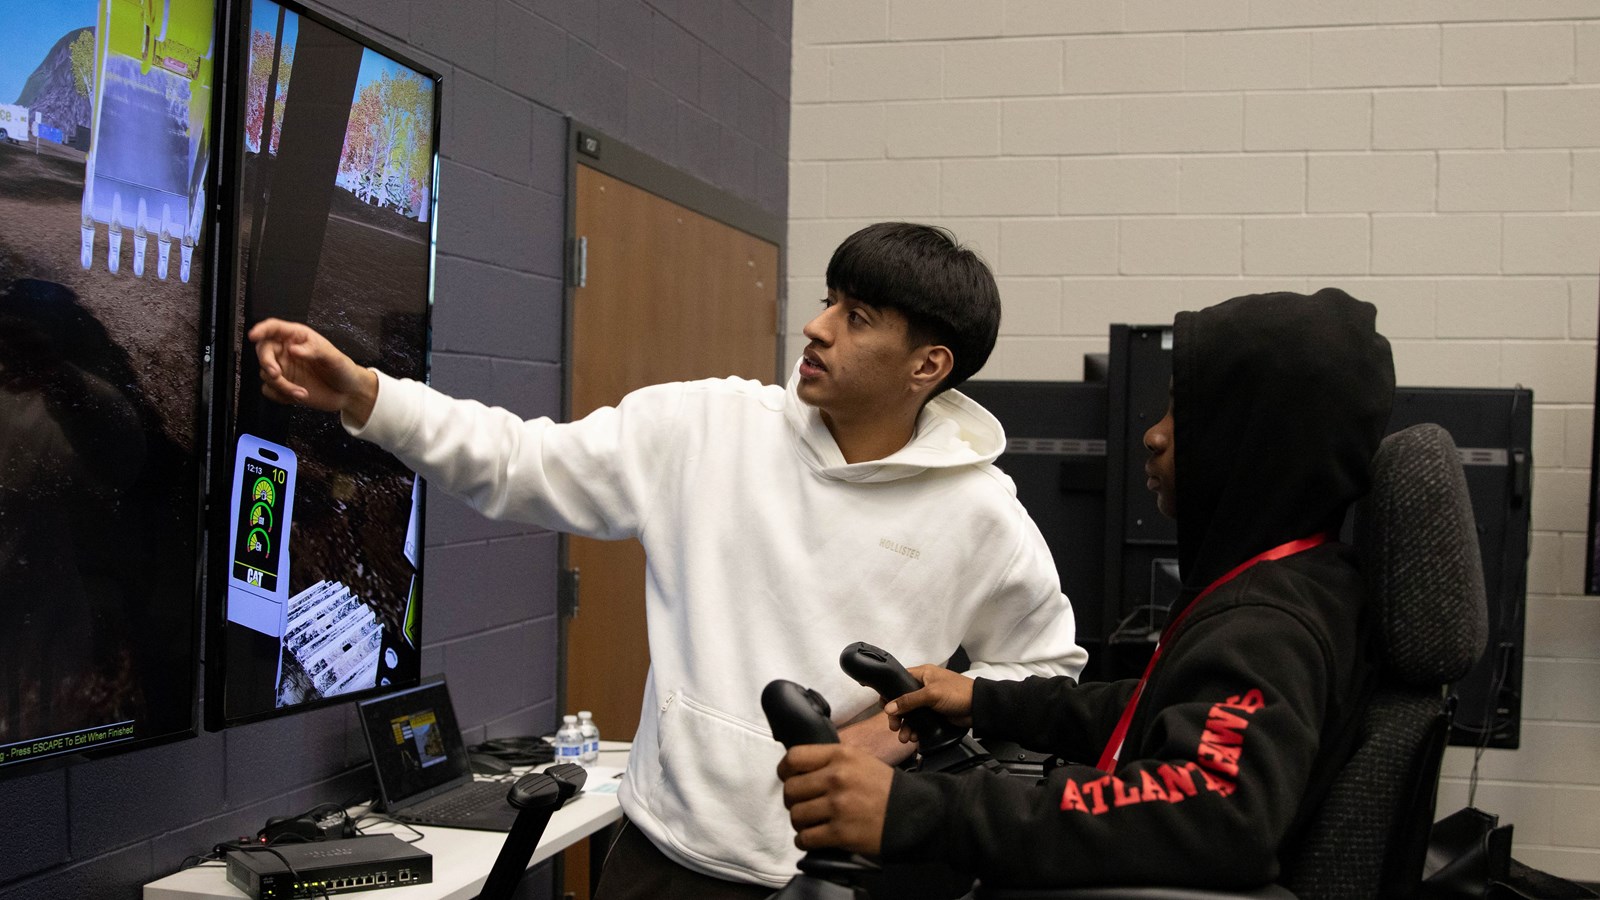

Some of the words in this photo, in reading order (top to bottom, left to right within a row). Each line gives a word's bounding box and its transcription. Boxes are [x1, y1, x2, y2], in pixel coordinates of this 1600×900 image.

[247, 464, 263, 475] 12:13
[272, 468, 286, 485] 10
[879, 537, 921, 560] HOLLISTER
[247, 568, 263, 587] CAT
[10, 746, 31, 757] Press
[32, 738, 63, 753] ESCAPE
[65, 737, 73, 747] To
[75, 735, 87, 745] Exit
[88, 731, 107, 742] When
[108, 725, 134, 738] Finished
